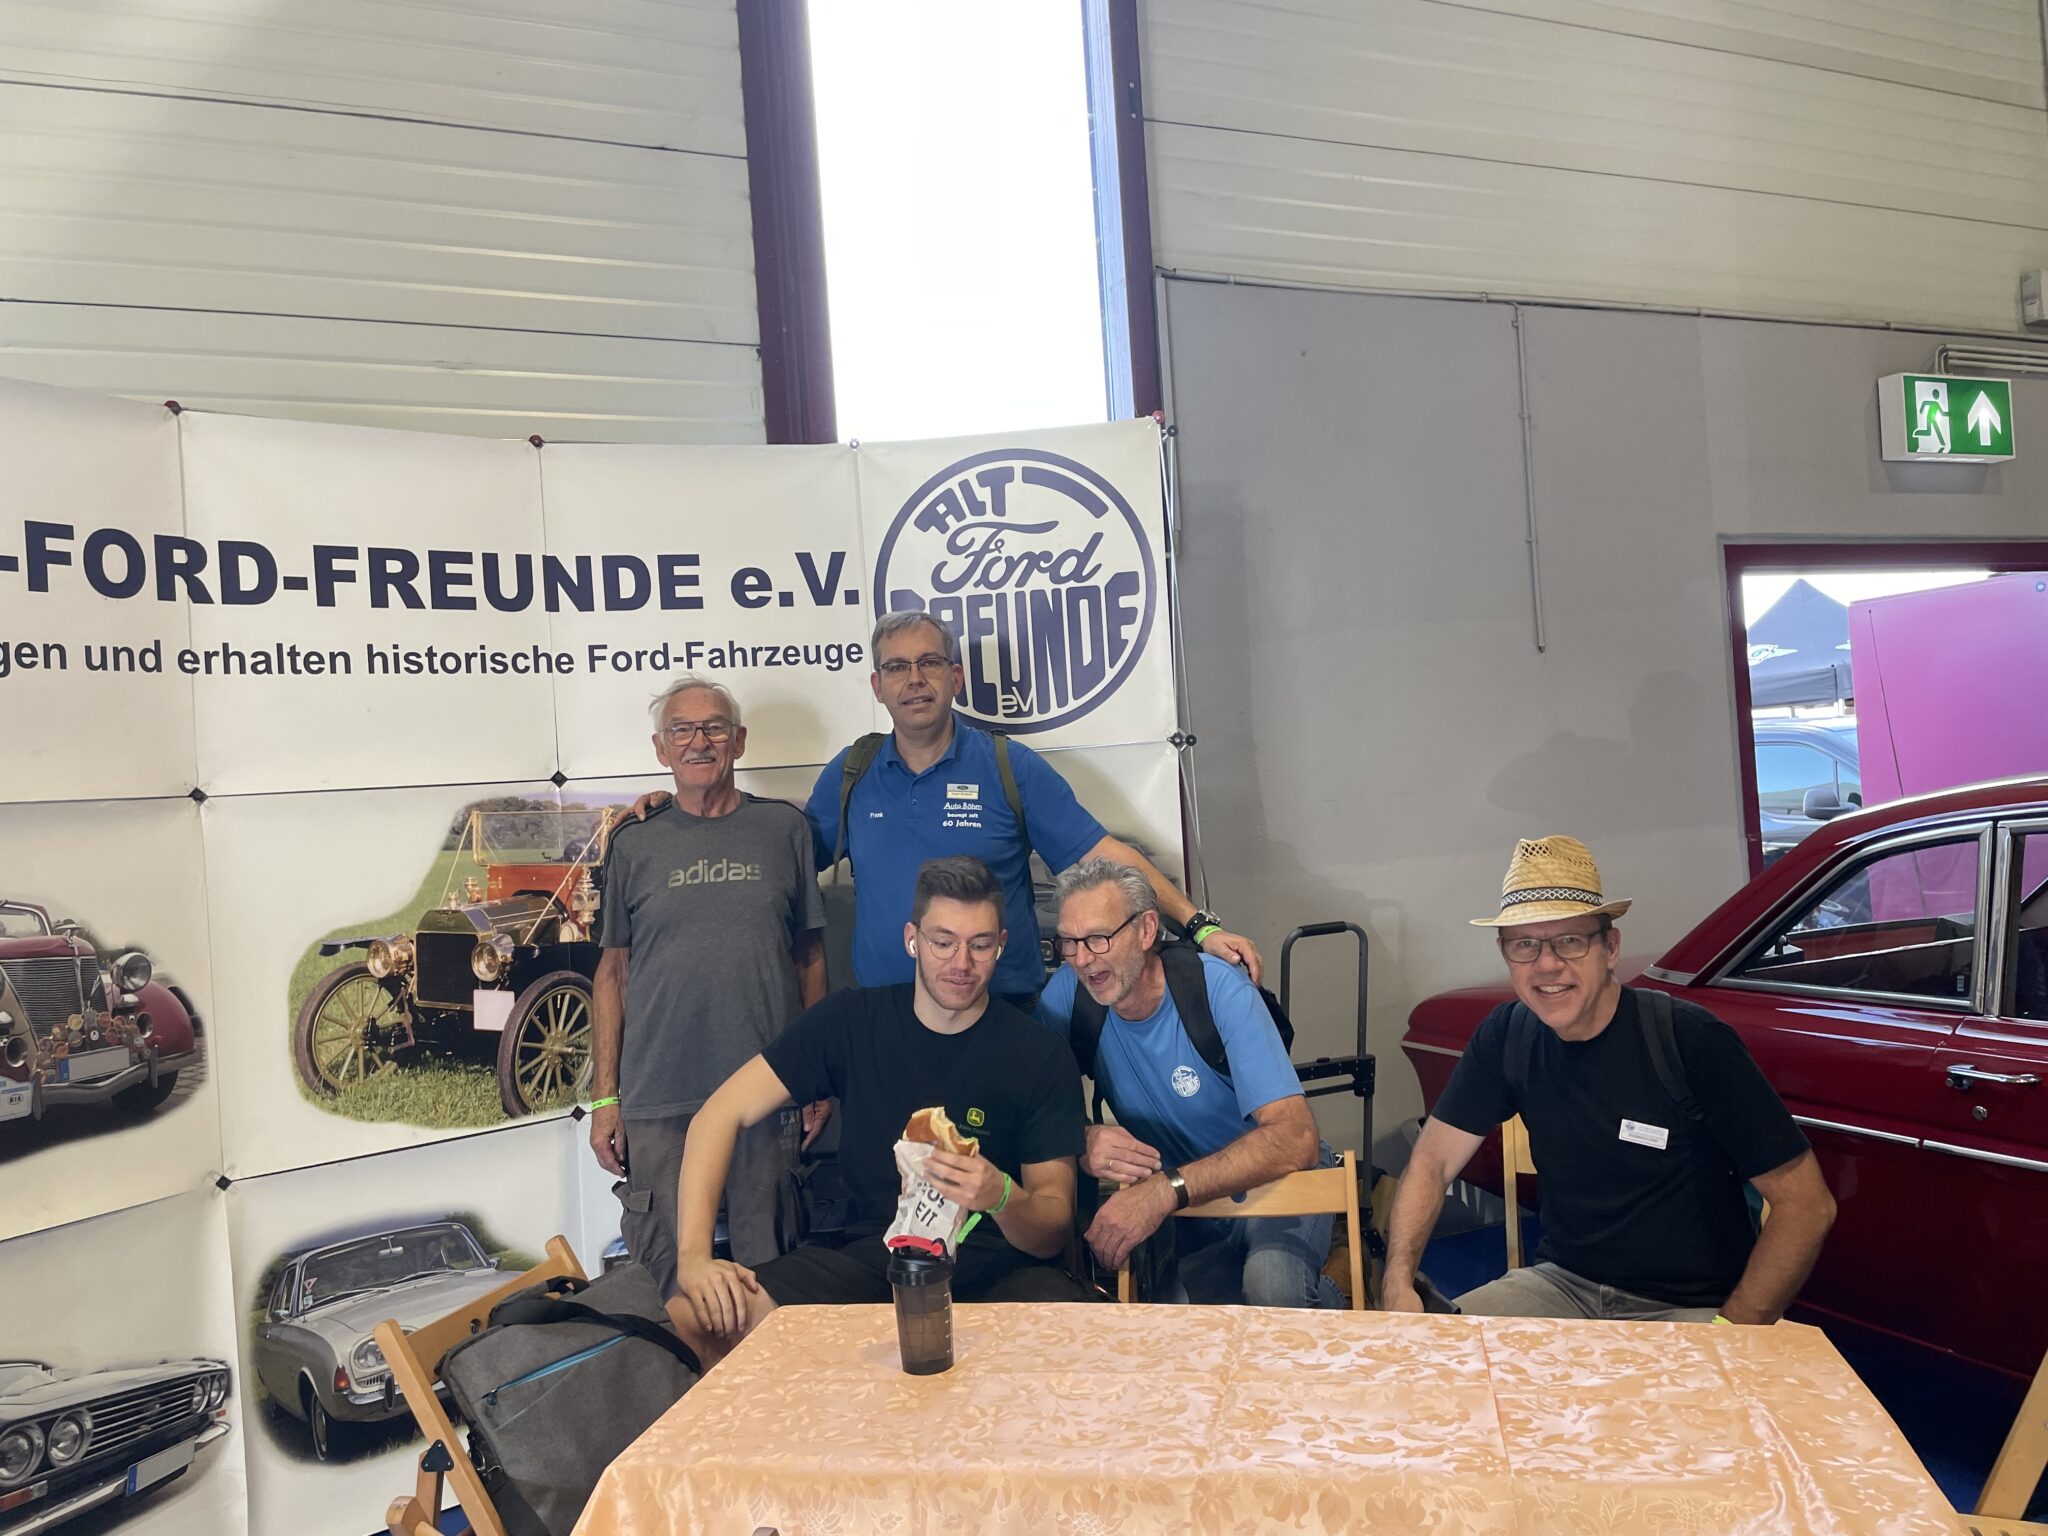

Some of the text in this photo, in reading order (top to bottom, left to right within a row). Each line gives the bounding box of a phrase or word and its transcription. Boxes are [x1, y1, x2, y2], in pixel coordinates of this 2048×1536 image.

[914, 466, 1015, 534] ALT
[730, 551, 860, 609] e.V.
[931, 520, 1104, 594] Ford
[84, 639, 163, 673] und
[177, 642, 352, 675] erhalten
[367, 643, 575, 675] historische
[588, 640, 864, 673] Ford-Fahrzeuge
[955, 820, 982, 828] Jahren
[667, 858, 762, 888] adidas
